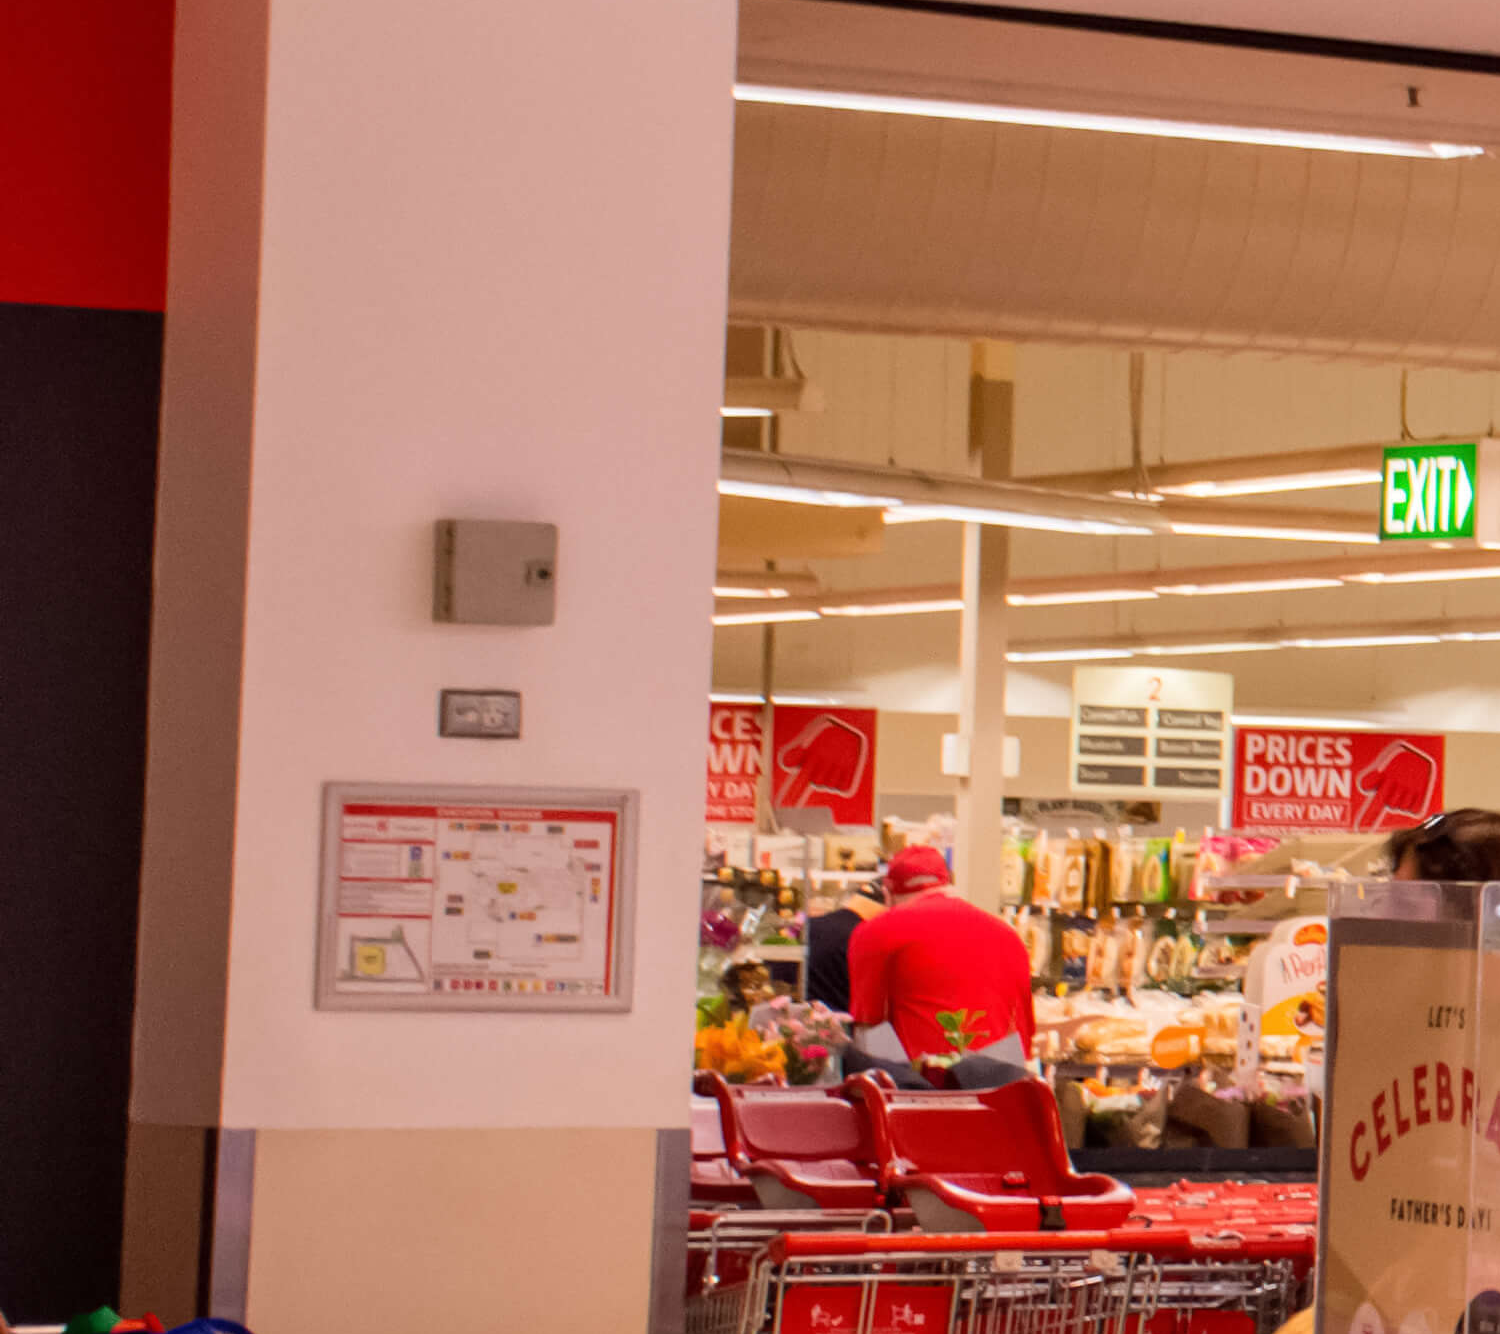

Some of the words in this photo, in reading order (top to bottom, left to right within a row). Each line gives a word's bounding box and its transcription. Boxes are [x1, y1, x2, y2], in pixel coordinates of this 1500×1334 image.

[1385, 456, 1457, 533] EXIT
[1149, 676, 1163, 702] 2
[1245, 733, 1353, 765] PRICES
[1243, 766, 1351, 798] DOWN
[1251, 803, 1303, 820] EVERY
[1308, 804, 1345, 822] DAY
[1427, 1005, 1466, 1030] LET'S
[1390, 1197, 1453, 1226] FATHER'S
